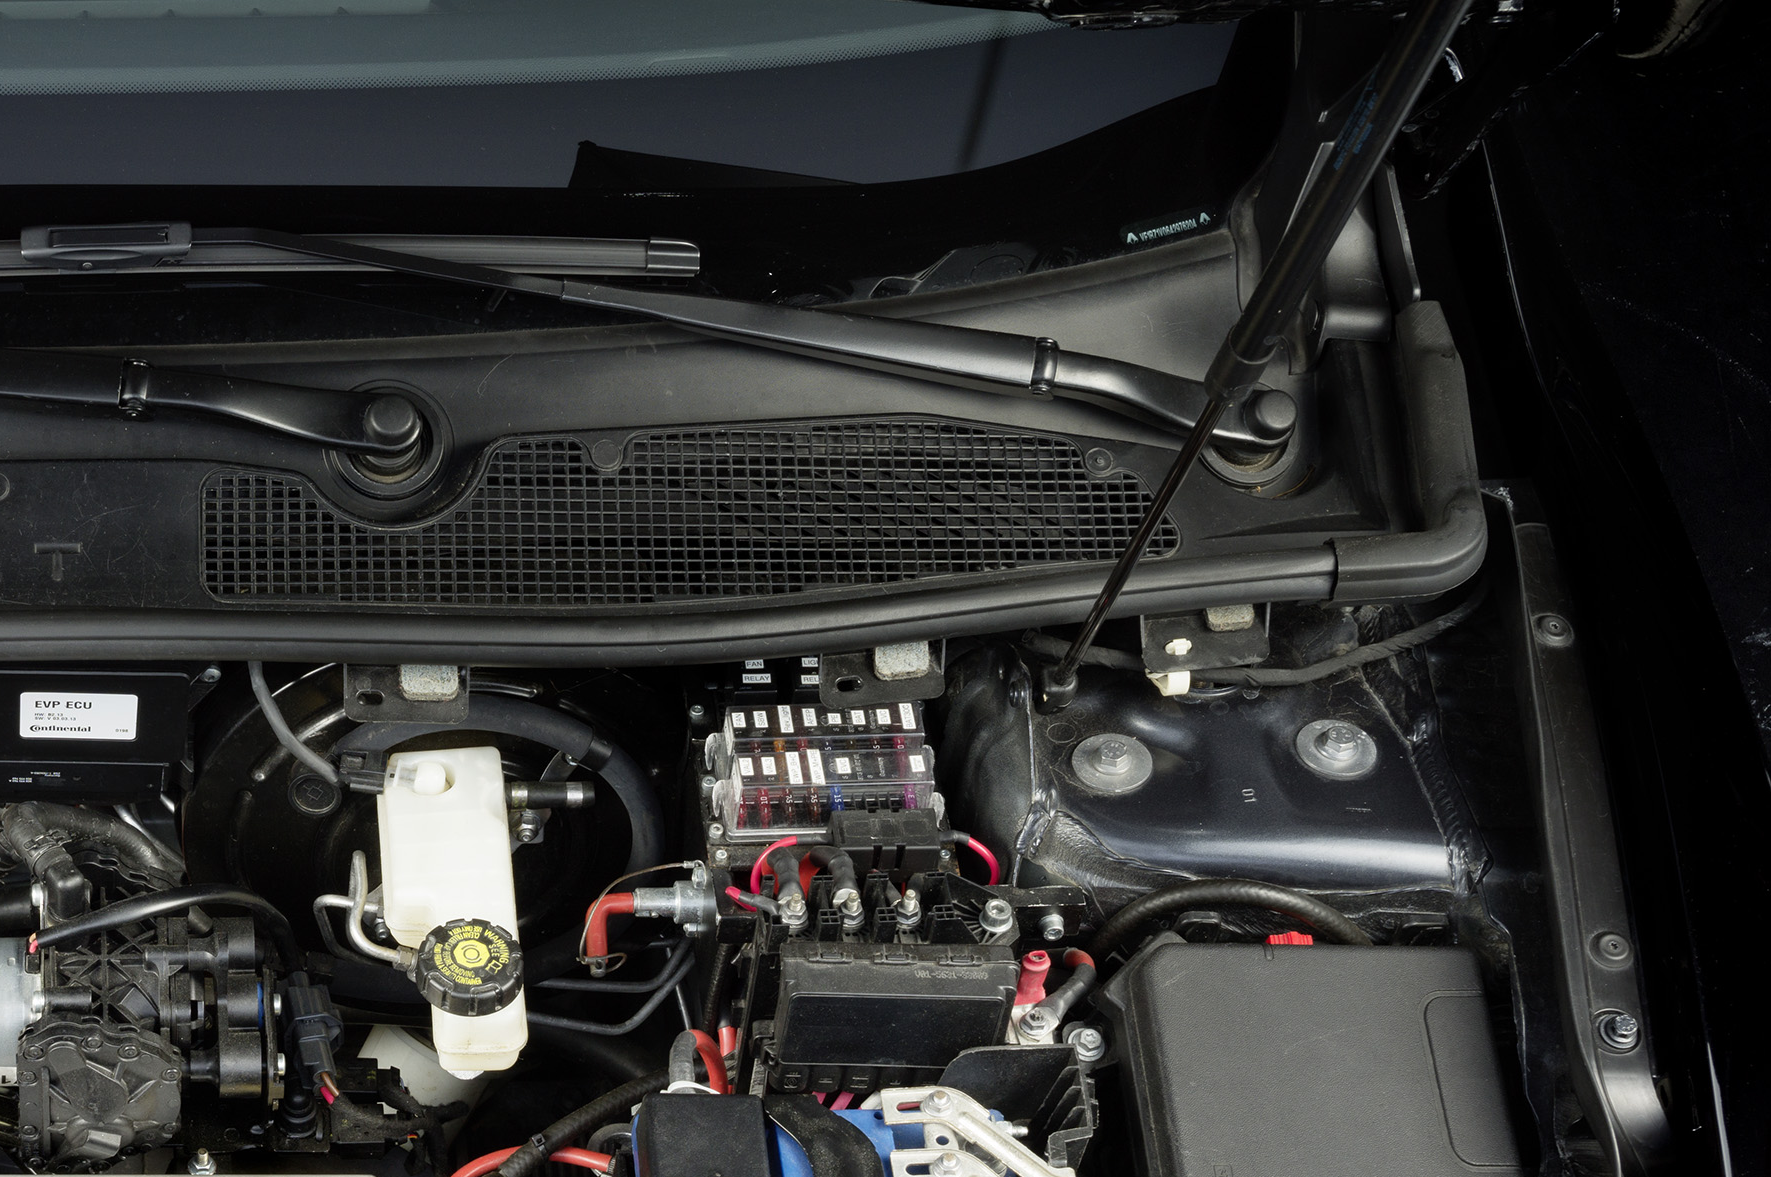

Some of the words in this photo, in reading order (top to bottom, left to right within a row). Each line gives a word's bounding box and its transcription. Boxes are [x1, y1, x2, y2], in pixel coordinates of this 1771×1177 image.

[35, 700, 61, 709] EVP
[66, 701, 92, 710] ECU
[29, 724, 92, 732] Continental
[484, 928, 510, 964] WARNING
